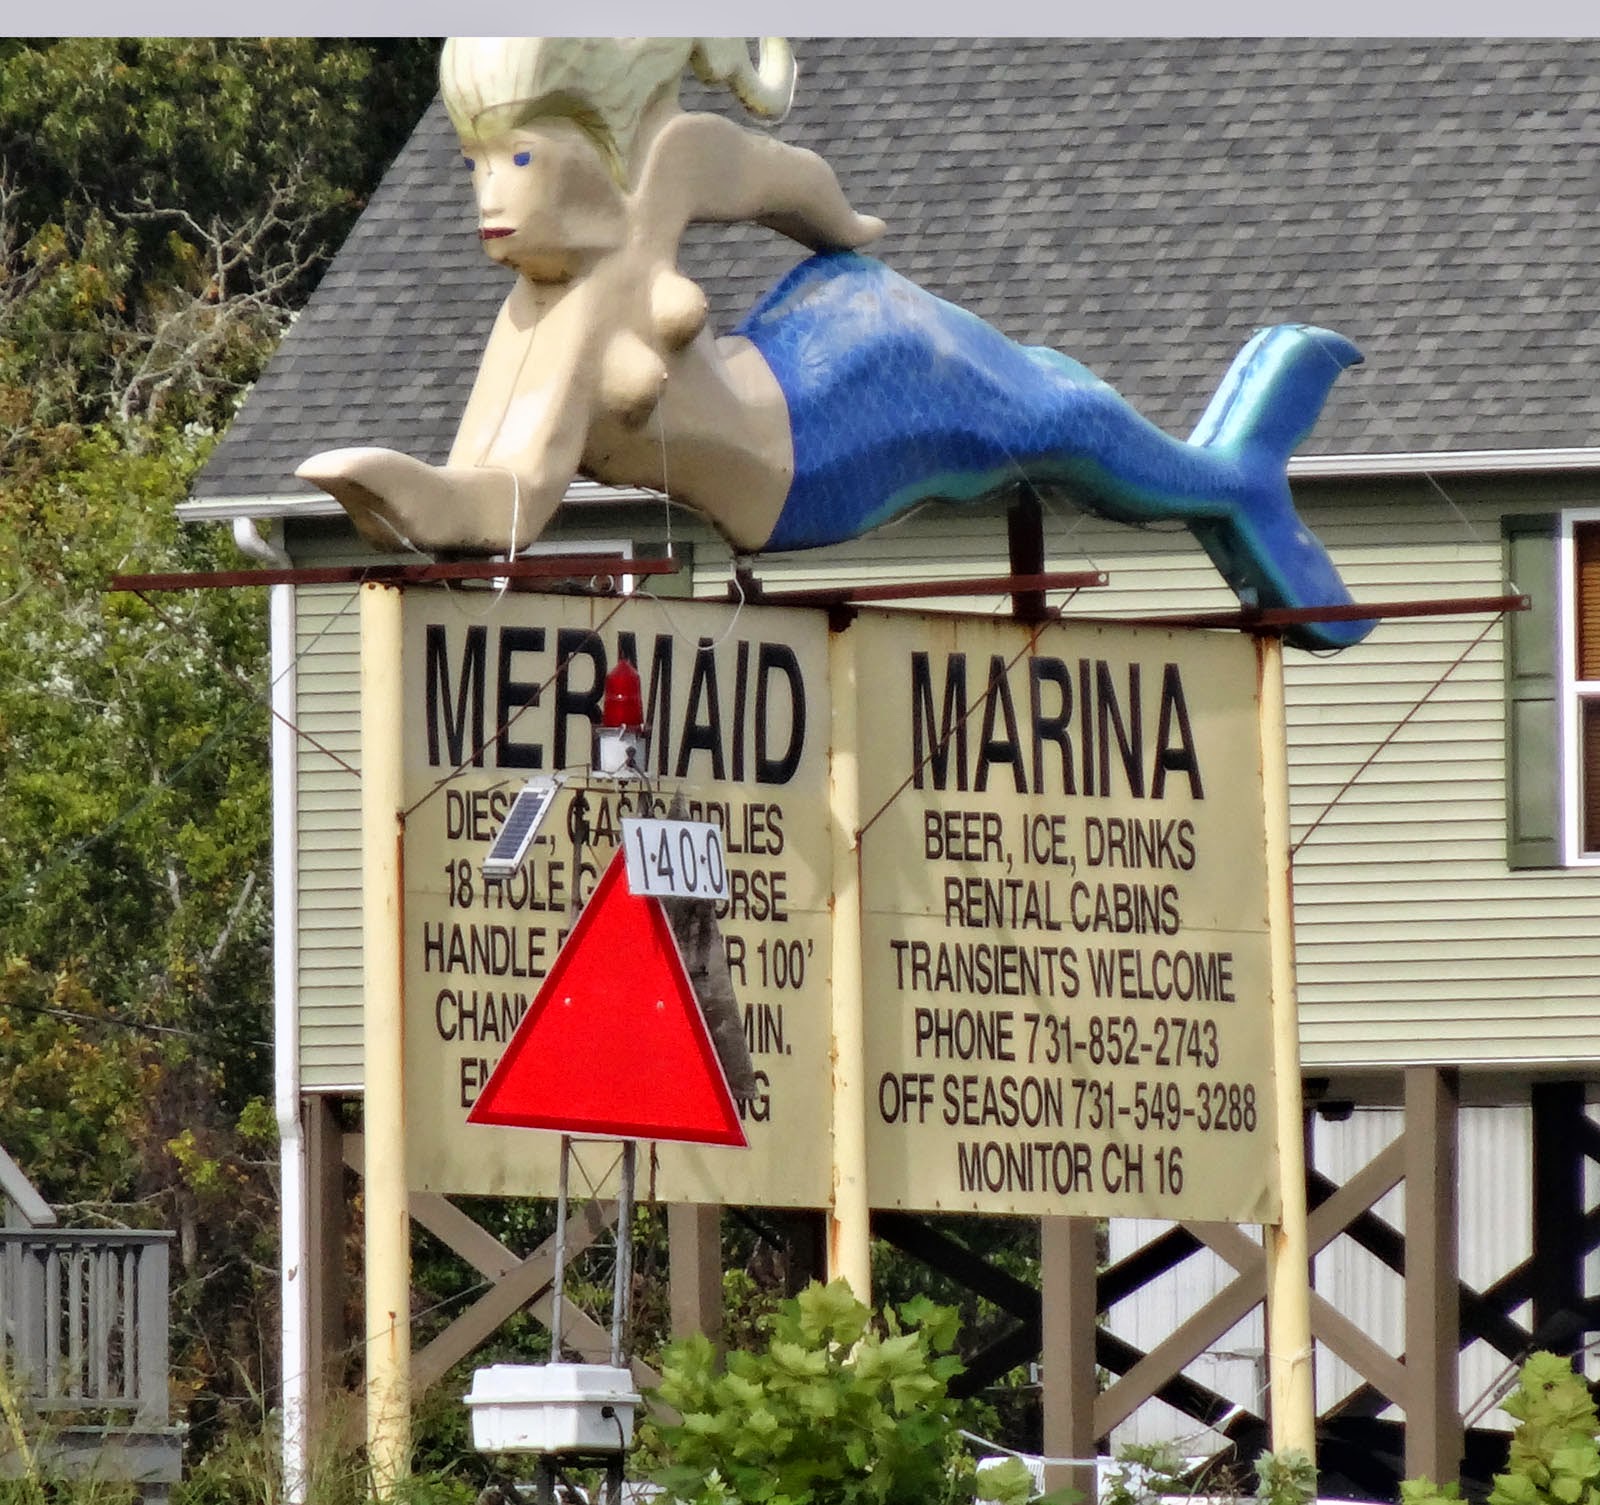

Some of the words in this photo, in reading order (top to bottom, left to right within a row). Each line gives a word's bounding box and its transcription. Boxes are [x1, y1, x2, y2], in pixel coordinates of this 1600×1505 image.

[426, 624, 806, 785] MERMAID
[911, 651, 1205, 800] MARINA
[446, 789, 556, 856] DIES,
[924, 809, 1013, 874] BEER,
[1023, 814, 1076, 877] ICE,
[1085, 816, 1196, 871] DRINKS
[445, 858, 473, 909] 18
[482, 859, 566, 912] HOLE
[944, 876, 1062, 932] RENTAL
[1070, 881, 1180, 935] CABINS
[424, 921, 547, 978] HANDLE
[890, 939, 1080, 998] TRANSIENTS
[1086, 948, 1236, 1003] WELCOME
[435, 988, 534, 1043] CHAN
[915, 1008, 1016, 1062] PHONE
[1024, 1013, 1219, 1068] 731-852-2743
[879, 1073, 935, 1124] OFF
[942, 1074, 1063, 1128] SEASON
[1072, 1078, 1257, 1132] 731-549-3288
[957, 1141, 1093, 1195] MONITOR
[1101, 1143, 1144, 1194] CH
[1154, 1146, 1183, 1195] 16
